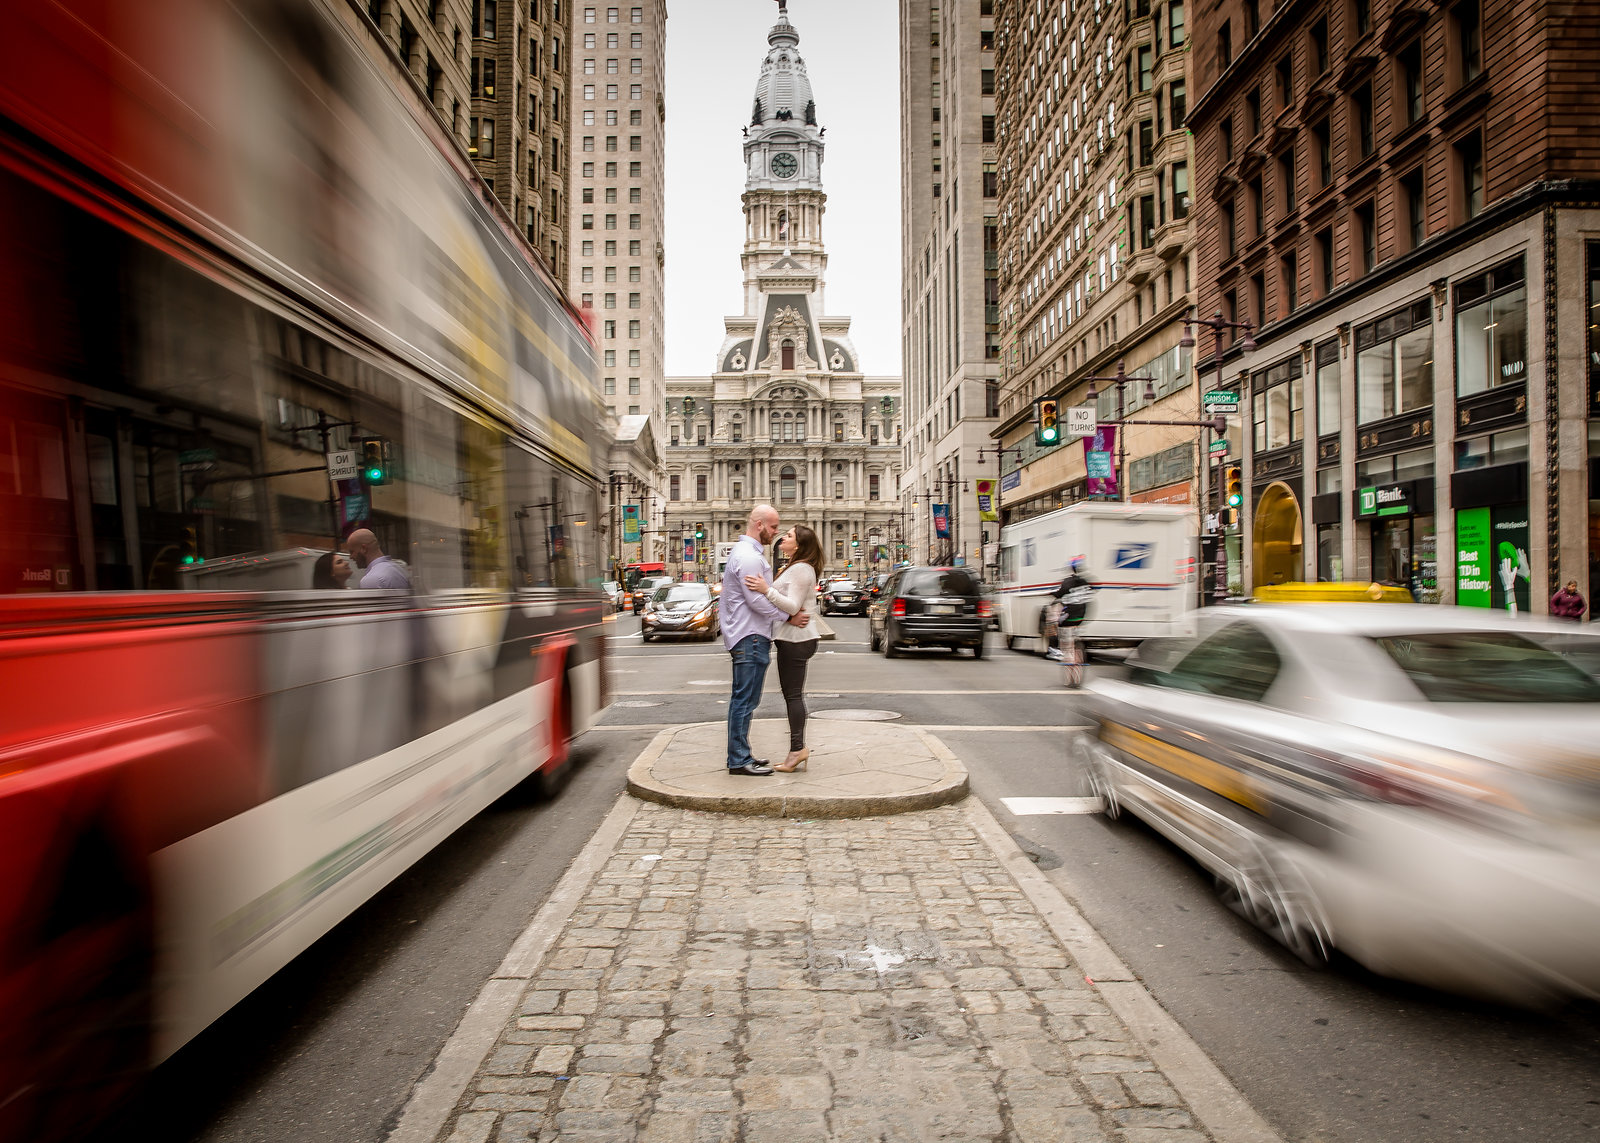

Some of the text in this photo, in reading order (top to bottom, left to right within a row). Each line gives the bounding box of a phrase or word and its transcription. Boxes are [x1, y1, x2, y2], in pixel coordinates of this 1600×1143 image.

[1075, 411, 1089, 420] NO
[1070, 423, 1095, 432] TURNS
[1361, 486, 1402, 509] TD Bank
[1459, 550, 1478, 562] Best
[1459, 564, 1480, 576] TD in
[1459, 578, 1491, 592] History.
